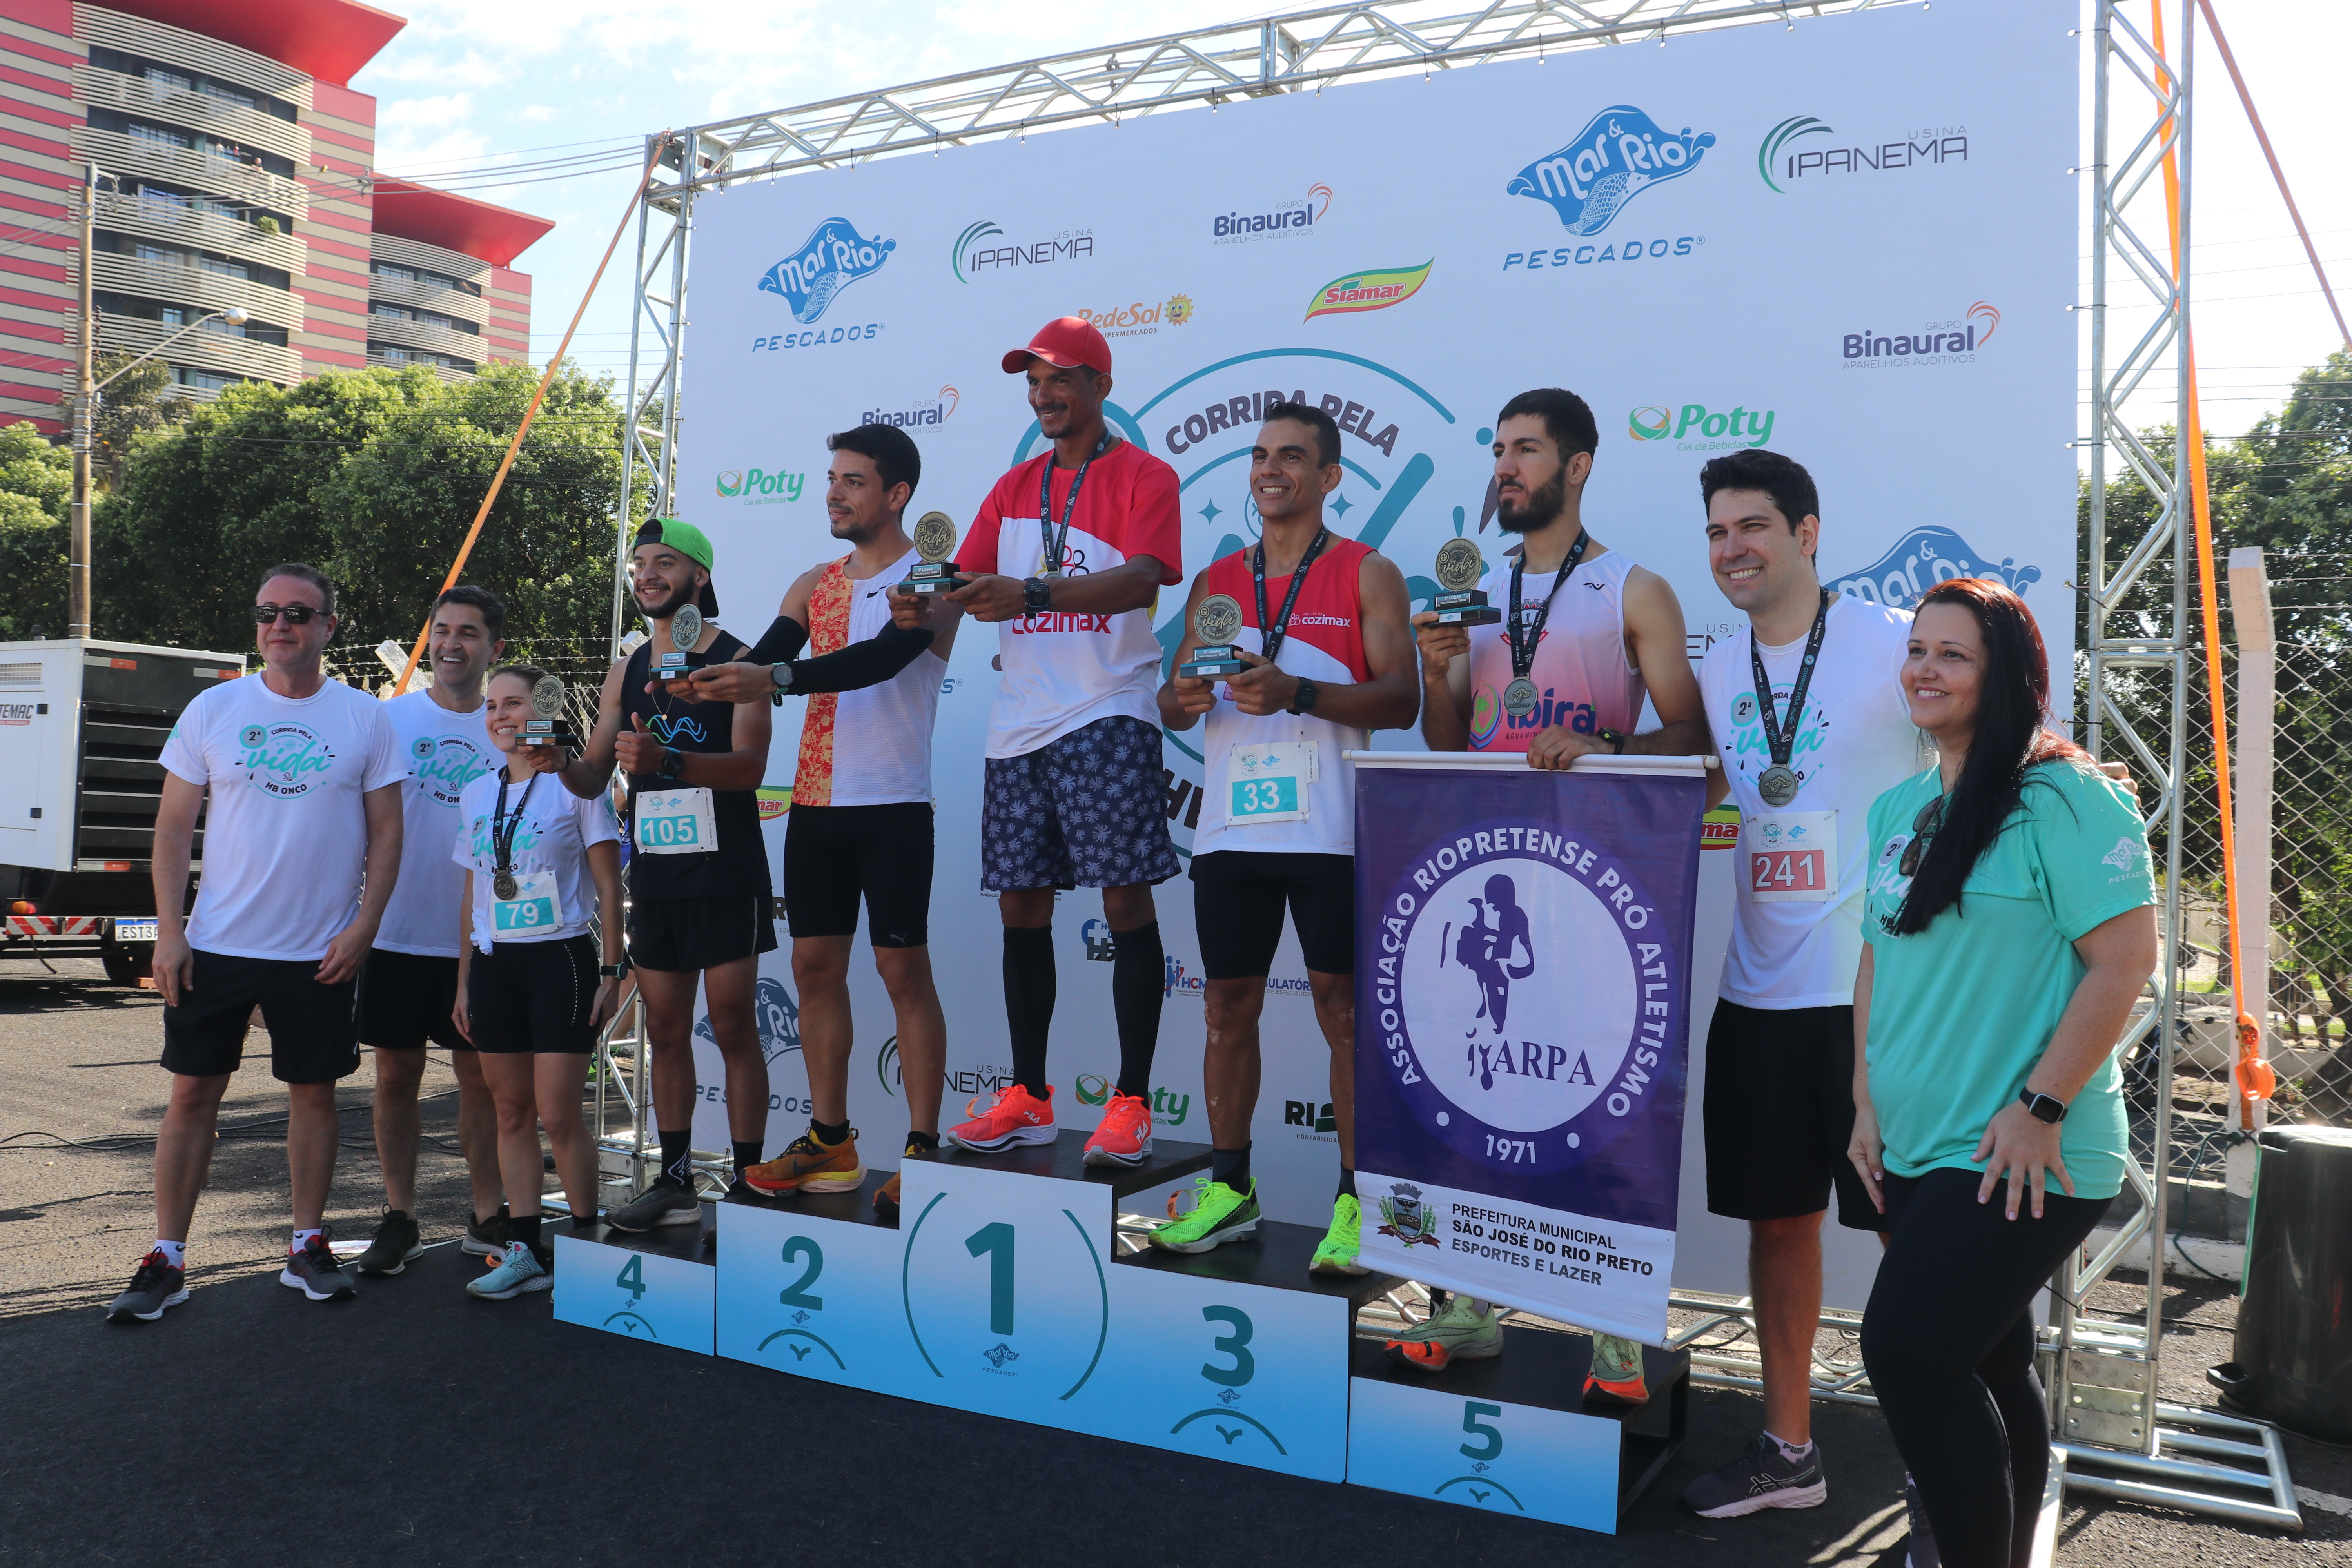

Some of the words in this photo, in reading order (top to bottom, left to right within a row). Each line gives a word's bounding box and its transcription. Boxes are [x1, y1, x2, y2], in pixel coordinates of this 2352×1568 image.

[1908, 125, 1967, 140] USINA
[1609, 118, 1624, 138] &
[1619, 132, 1687, 171] Rio
[1789, 136, 1967, 178] IPANEMA
[1276, 200, 1303, 210] GRUPO
[1214, 204, 1313, 236] Binaural
[1053, 228, 1093, 240] USINA
[1213, 234, 1264, 246] APARELHOS
[1266, 228, 1313, 240] AUDITIVOS
[826, 228, 837, 243] &
[832, 240, 877, 271] Rio
[972, 237, 1093, 272] IPANEMA
[1324, 283, 1406, 304] Siamar
[1102, 328, 1157, 339] UPERMERCADOS
[1926, 320, 1962, 330] GRUPO
[1844, 325, 1974, 358] Binaural
[1842, 358, 1909, 369] APARELHOS
[1913, 354, 1975, 365] AUDITIVOS
[913, 399, 935, 408] GRUPO
[862, 404, 943, 427] Binaural
[1320, 394, 1399, 457] PELA
[1673, 404, 1775, 447] Poty
[905, 426, 943, 436] AUDITIVOS
[1677, 443, 1693, 451] Cia.
[1709, 441, 1746, 449] Bebidas
[742, 468, 804, 502] Poty
[920, 526, 950, 546] vida
[1920, 539, 1938, 561] &
[1443, 553, 1476, 573] vida
[1012, 612, 1113, 634] cozimax
[1202, 610, 1236, 629] vida
[1280, 604, 1289, 624] CORRIDA
[1302, 614, 1351, 628] cozimax
[675, 619, 697, 636] vida
[1706, 624, 1749, 633] USIN
[1798, 667, 1808, 690] CORRIDA
[537, 689, 560, 705] vida
[298, 730, 312, 740] PELA
[1506, 731, 1523, 740] ÁGUA
[463, 742, 476, 753] PELA
[247, 740, 331, 779] vida
[418, 753, 487, 788] vida
[265, 782, 279, 792] HB
[281, 784, 307, 795] ONCO
[434, 791, 446, 800] HB
[1244, 781, 1280, 811] 33
[644, 818, 693, 844] 105
[1413, 827, 1597, 893] RIOPRETENSE
[2127, 844, 2140, 854] Rio
[1755, 854, 1814, 887] 241
[1596, 867, 1654, 930] PRÓ
[506, 902, 539, 927] 79
[1182, 977, 1206, 989] HCM
[1377, 893, 1422, 1086] ASSOCIAÇÃO
[760, 988, 771, 1004] &
[1606, 943, 1669, 1117] ATLETISMO
[976, 1064, 1014, 1074] USINA
[1491, 1039, 1597, 1087] ARPA
[1023, 1111, 1040, 1123] FILA
[1136, 1120, 1148, 1144] FILA
[1486, 1134, 1536, 1163] 1971
[1452, 1203, 1535, 1232] PREFEITURA
[1539, 1223, 1616, 1250] MUNICIPAL
[1453, 1218, 1484, 1237] SÃO
[1488, 1228, 1528, 1249] JOSÉ
[1534, 1240, 1556, 1254] DO
[1561, 1245, 1590, 1262] RIO
[1596, 1252, 1653, 1276] PRETO
[780, 1236, 823, 1310] 2
[1452, 1238, 1530, 1268] ESPORTES
[1535, 1259, 1544, 1272] E
[1549, 1261, 1602, 1286] LAZER
[616, 1254, 646, 1300] 4
[965, 1222, 1015, 1336] 1
[1002, 1349, 1014, 1359] Rio
[1201, 1305, 1255, 1387] 3
[1459, 1401, 1503, 1461] 5
[1783, 1443, 1805, 1454] PUMA
